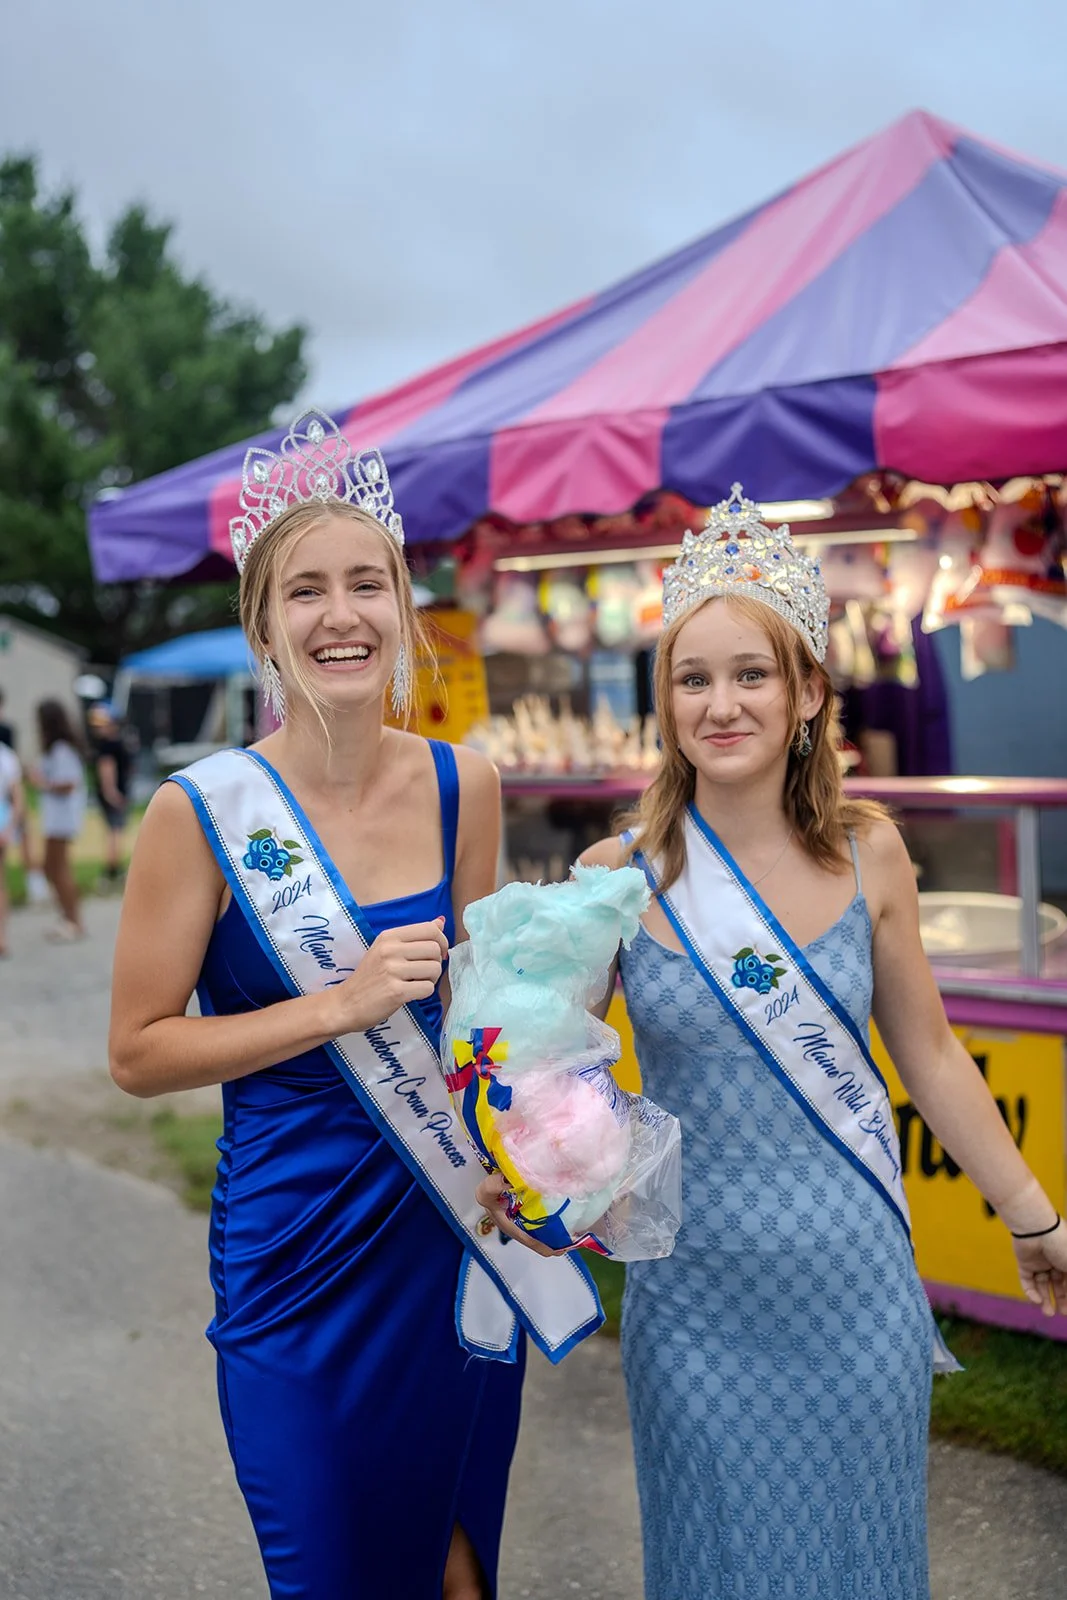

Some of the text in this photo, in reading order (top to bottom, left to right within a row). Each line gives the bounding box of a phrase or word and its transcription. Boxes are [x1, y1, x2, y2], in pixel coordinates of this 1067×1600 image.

[271, 874, 313, 915] 2024
[764, 984, 800, 1026] 2024
[293, 914, 467, 1168] Maine lueberry Crown Princess
[793, 1022, 840, 1078] Maine
[833, 1071, 871, 1114] Wild
